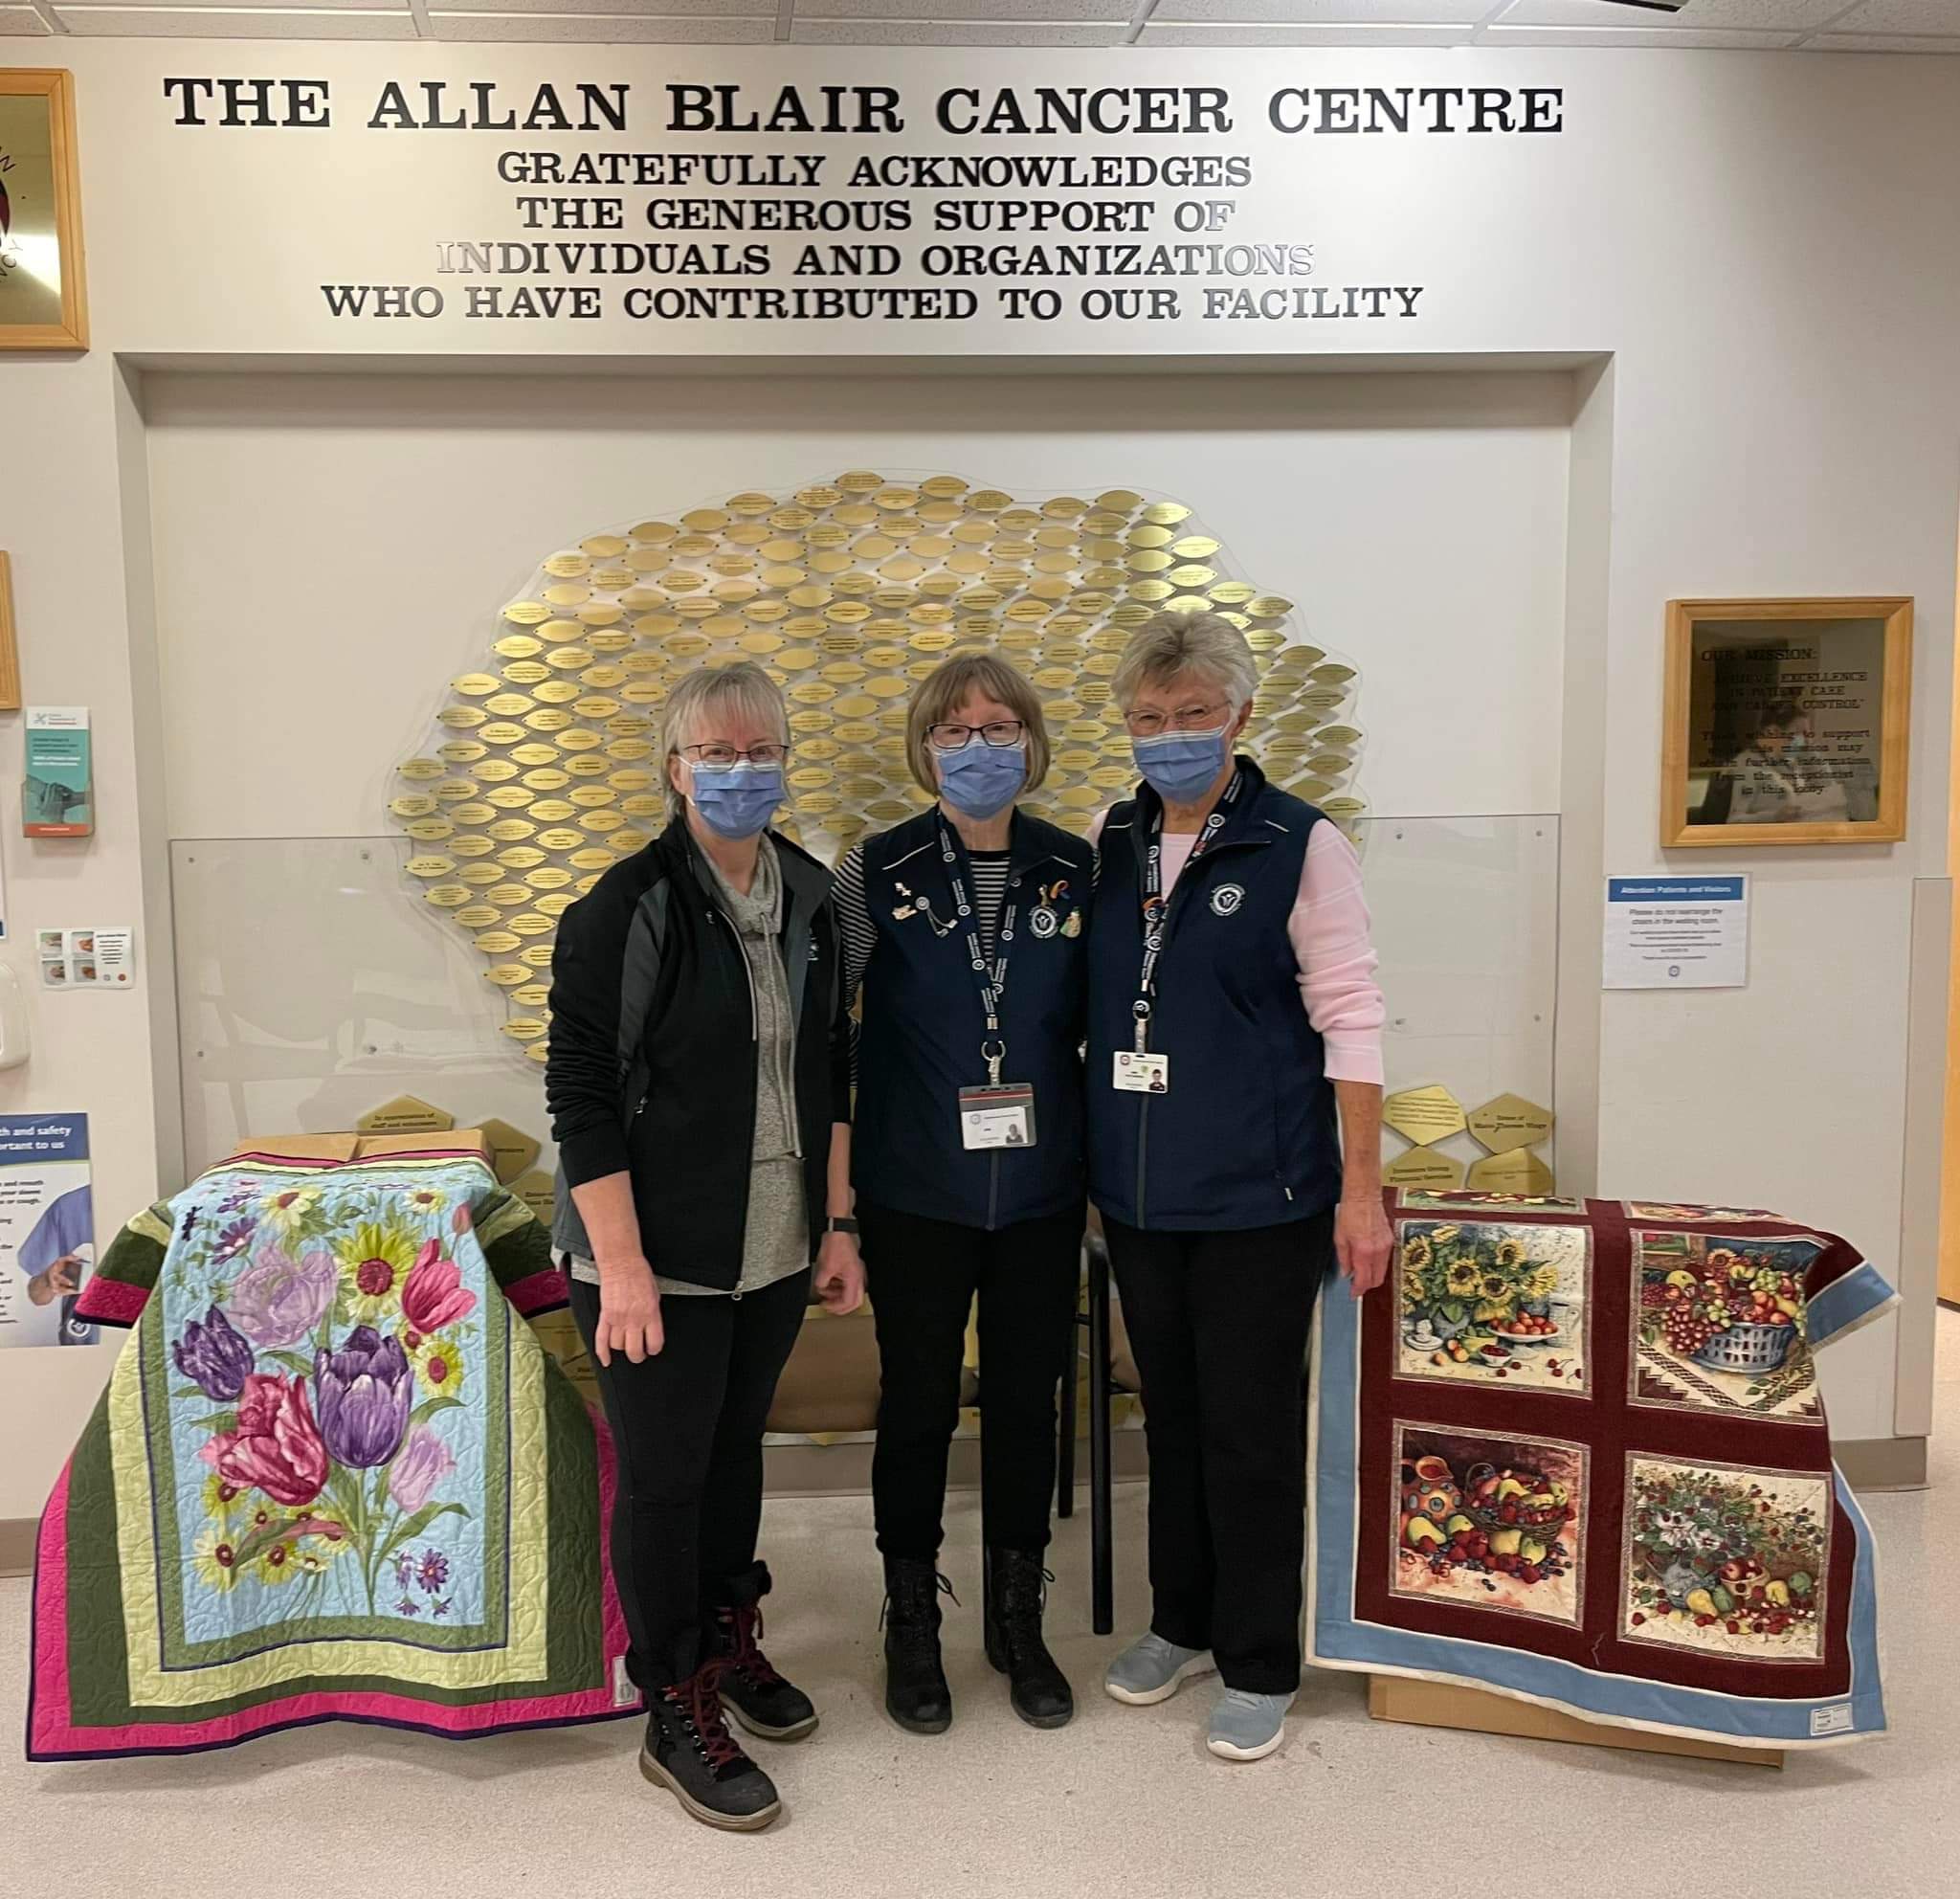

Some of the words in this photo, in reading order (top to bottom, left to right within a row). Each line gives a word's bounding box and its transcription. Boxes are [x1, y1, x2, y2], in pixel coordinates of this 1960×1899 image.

[164, 78, 331, 128] THE
[368, 80, 631, 131] ALLAN
[665, 83, 904, 133] BLAIR
[935, 86, 1235, 135] CANCER
[1268, 87, 1564, 133] CENTRE
[498, 151, 826, 188] GRATEFULLY
[848, 155, 1252, 188] ACKNOWLEDGES
[517, 196, 623, 231] THE
[646, 198, 912, 233] GENEROUS
[934, 200, 1156, 233] SUPPORT
[1173, 200, 1236, 233] OF
[435, 241, 769, 276] INDIVIDUALS
[793, 243, 902, 277] AND
[919, 244, 1316, 278] ORGANIZATIONS
[321, 285, 445, 319] WHO
[465, 286, 602, 320] HAVE
[623, 287, 979, 321] CONTRIBUTED
[998, 288, 1063, 321] TO
[1080, 289, 1182, 321] OUR
[1202, 286, 1425, 320] FACILITY
[13, 1126, 34, 1136] and
[37, 1125, 73, 1137] safety
